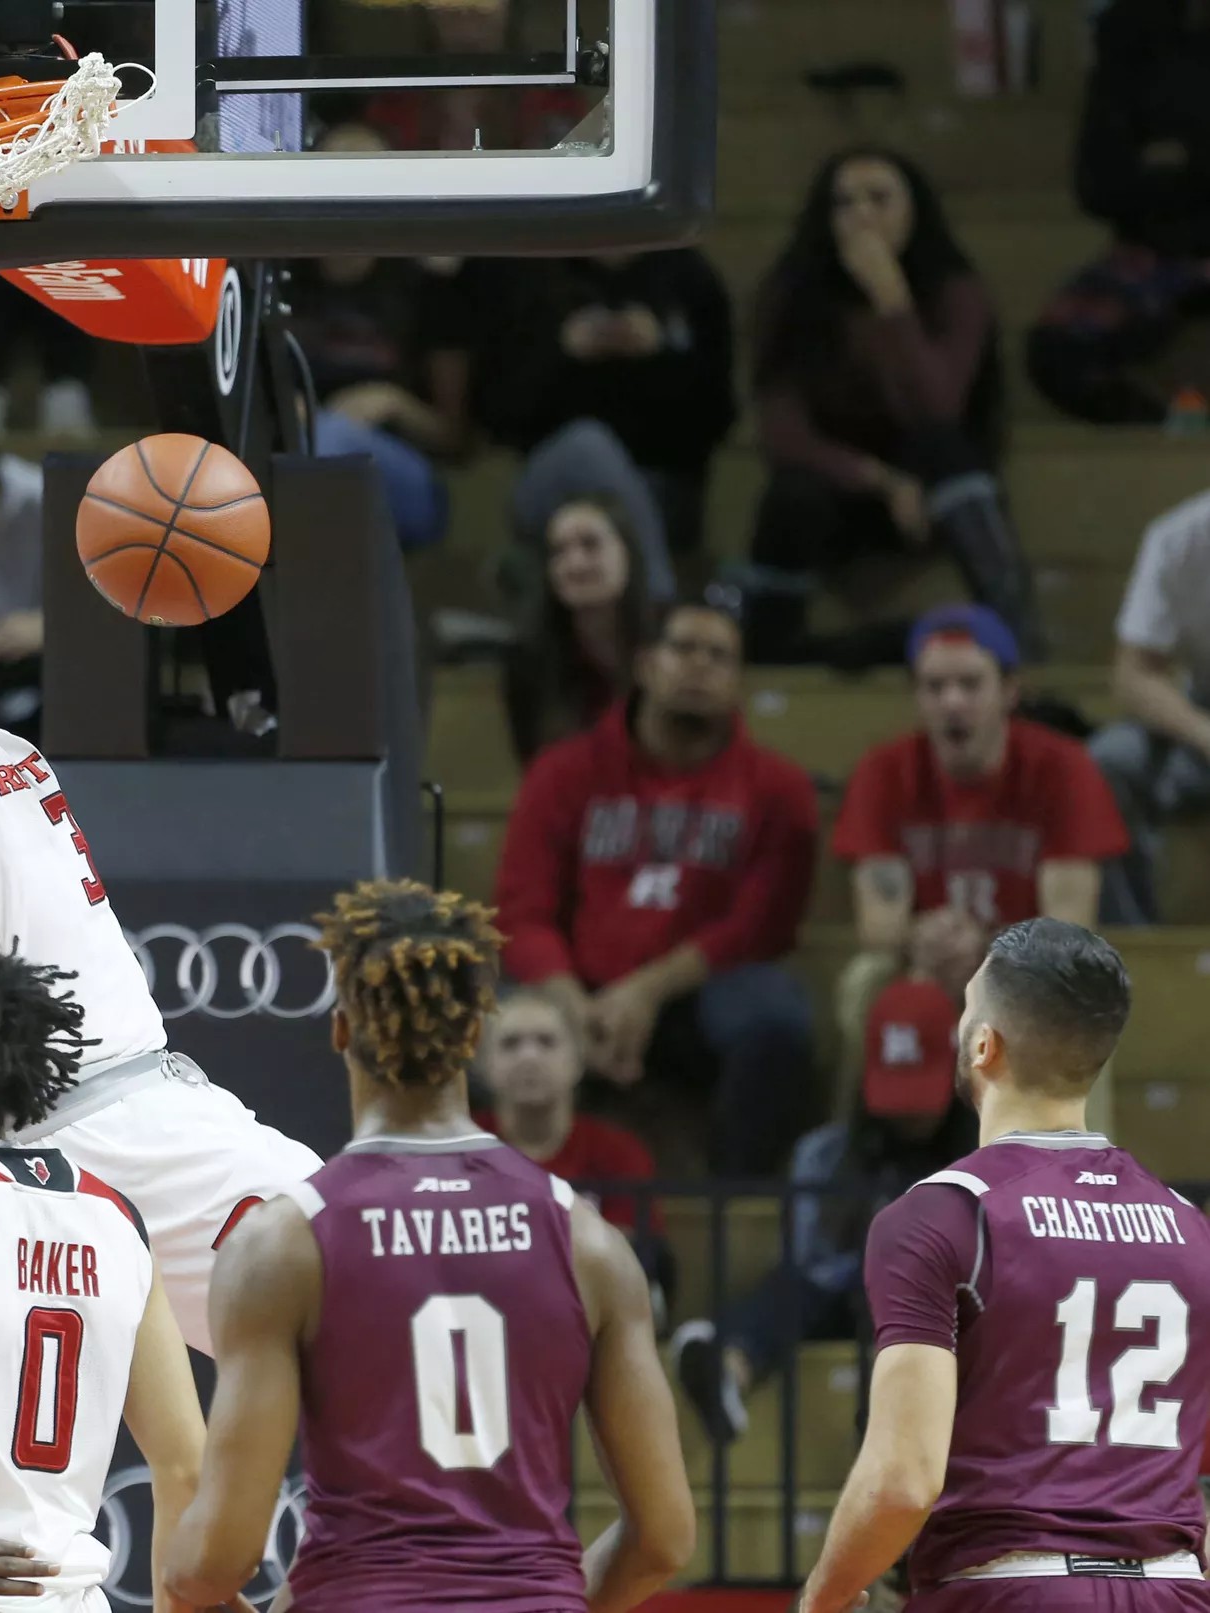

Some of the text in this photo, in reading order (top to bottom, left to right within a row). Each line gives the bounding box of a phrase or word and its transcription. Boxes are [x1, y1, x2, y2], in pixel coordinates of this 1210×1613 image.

[1075, 1171, 1118, 1186] A10
[361, 1203, 532, 1256] TAVARES
[1022, 1196, 1186, 1245] CHARTOUNY
[17, 1238, 100, 1297] BAKER
[11, 1306, 84, 1474] 0
[410, 1294, 511, 1471] 0
[1046, 1276, 1189, 1450] 12
